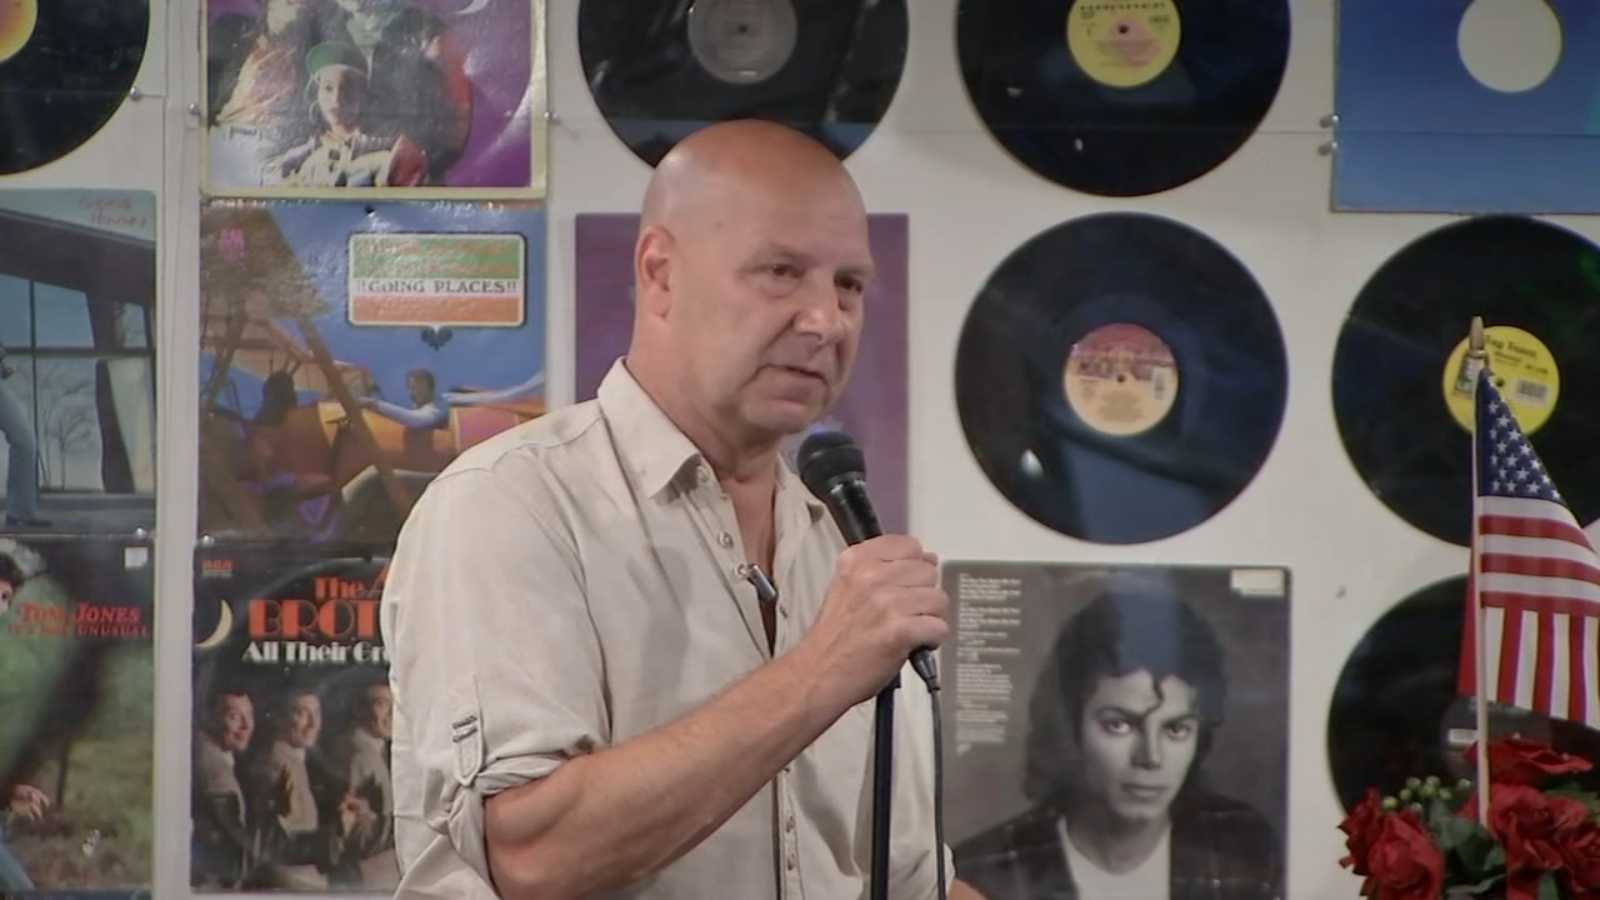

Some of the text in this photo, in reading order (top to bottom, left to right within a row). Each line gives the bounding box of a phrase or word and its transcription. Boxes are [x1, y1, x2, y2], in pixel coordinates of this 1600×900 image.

[315, 577, 363, 599] The
[74, 602, 141, 622] JONES
[78, 624, 147, 637] UNUSUAL
[242, 641, 280, 662] All
[284, 641, 349, 662] Their
